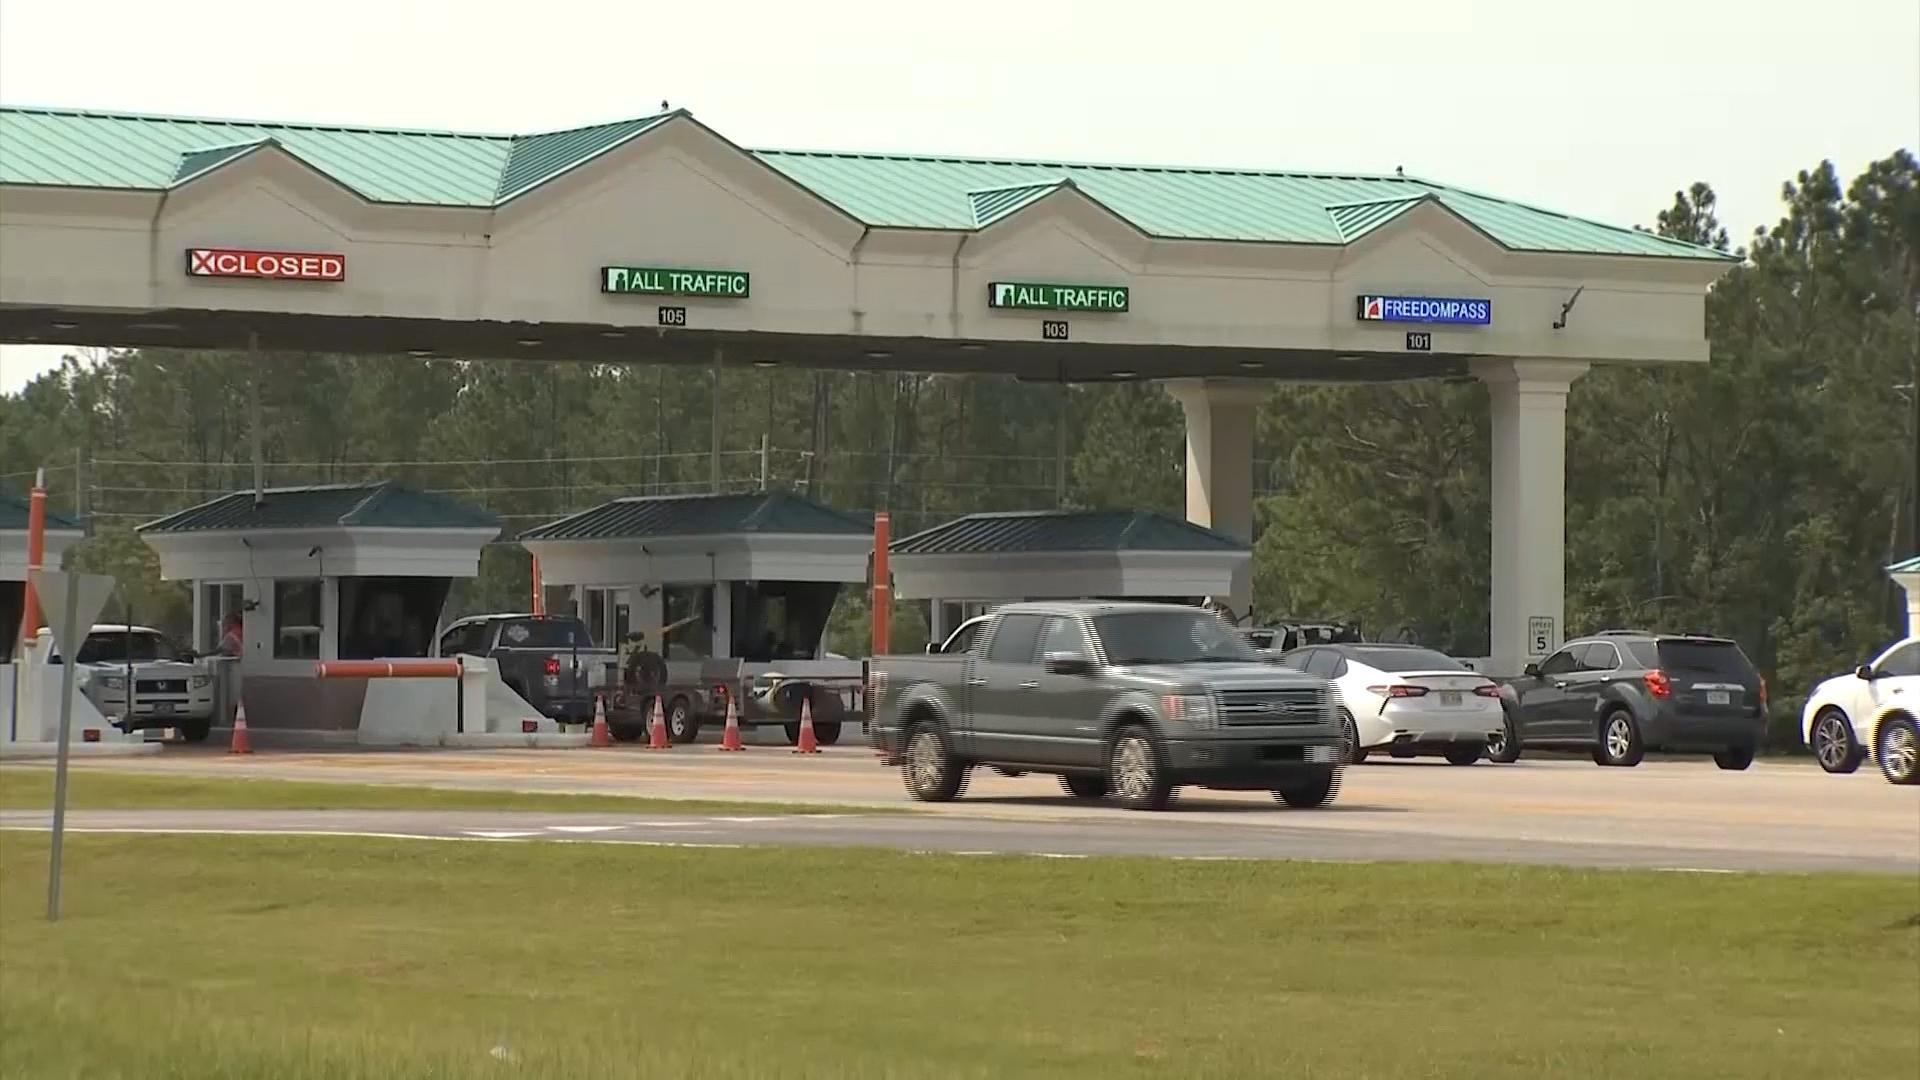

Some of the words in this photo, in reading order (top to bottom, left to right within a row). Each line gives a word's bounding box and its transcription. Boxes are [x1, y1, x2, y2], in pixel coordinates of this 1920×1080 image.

[216, 254, 342, 277] CLOSED
[631, 272, 664, 290] ALL
[669, 273, 746, 294] TRAFFIC
[1017, 287, 1049, 305] ALL
[1053, 289, 1125, 308] TRAFFIC
[660, 309, 685, 324] 105
[1384, 300, 1487, 319] FREEDOMPASS
[1044, 323, 1068, 337] 103
[1408, 335, 1430, 348] 101
[1536, 636, 1546, 650] 5
